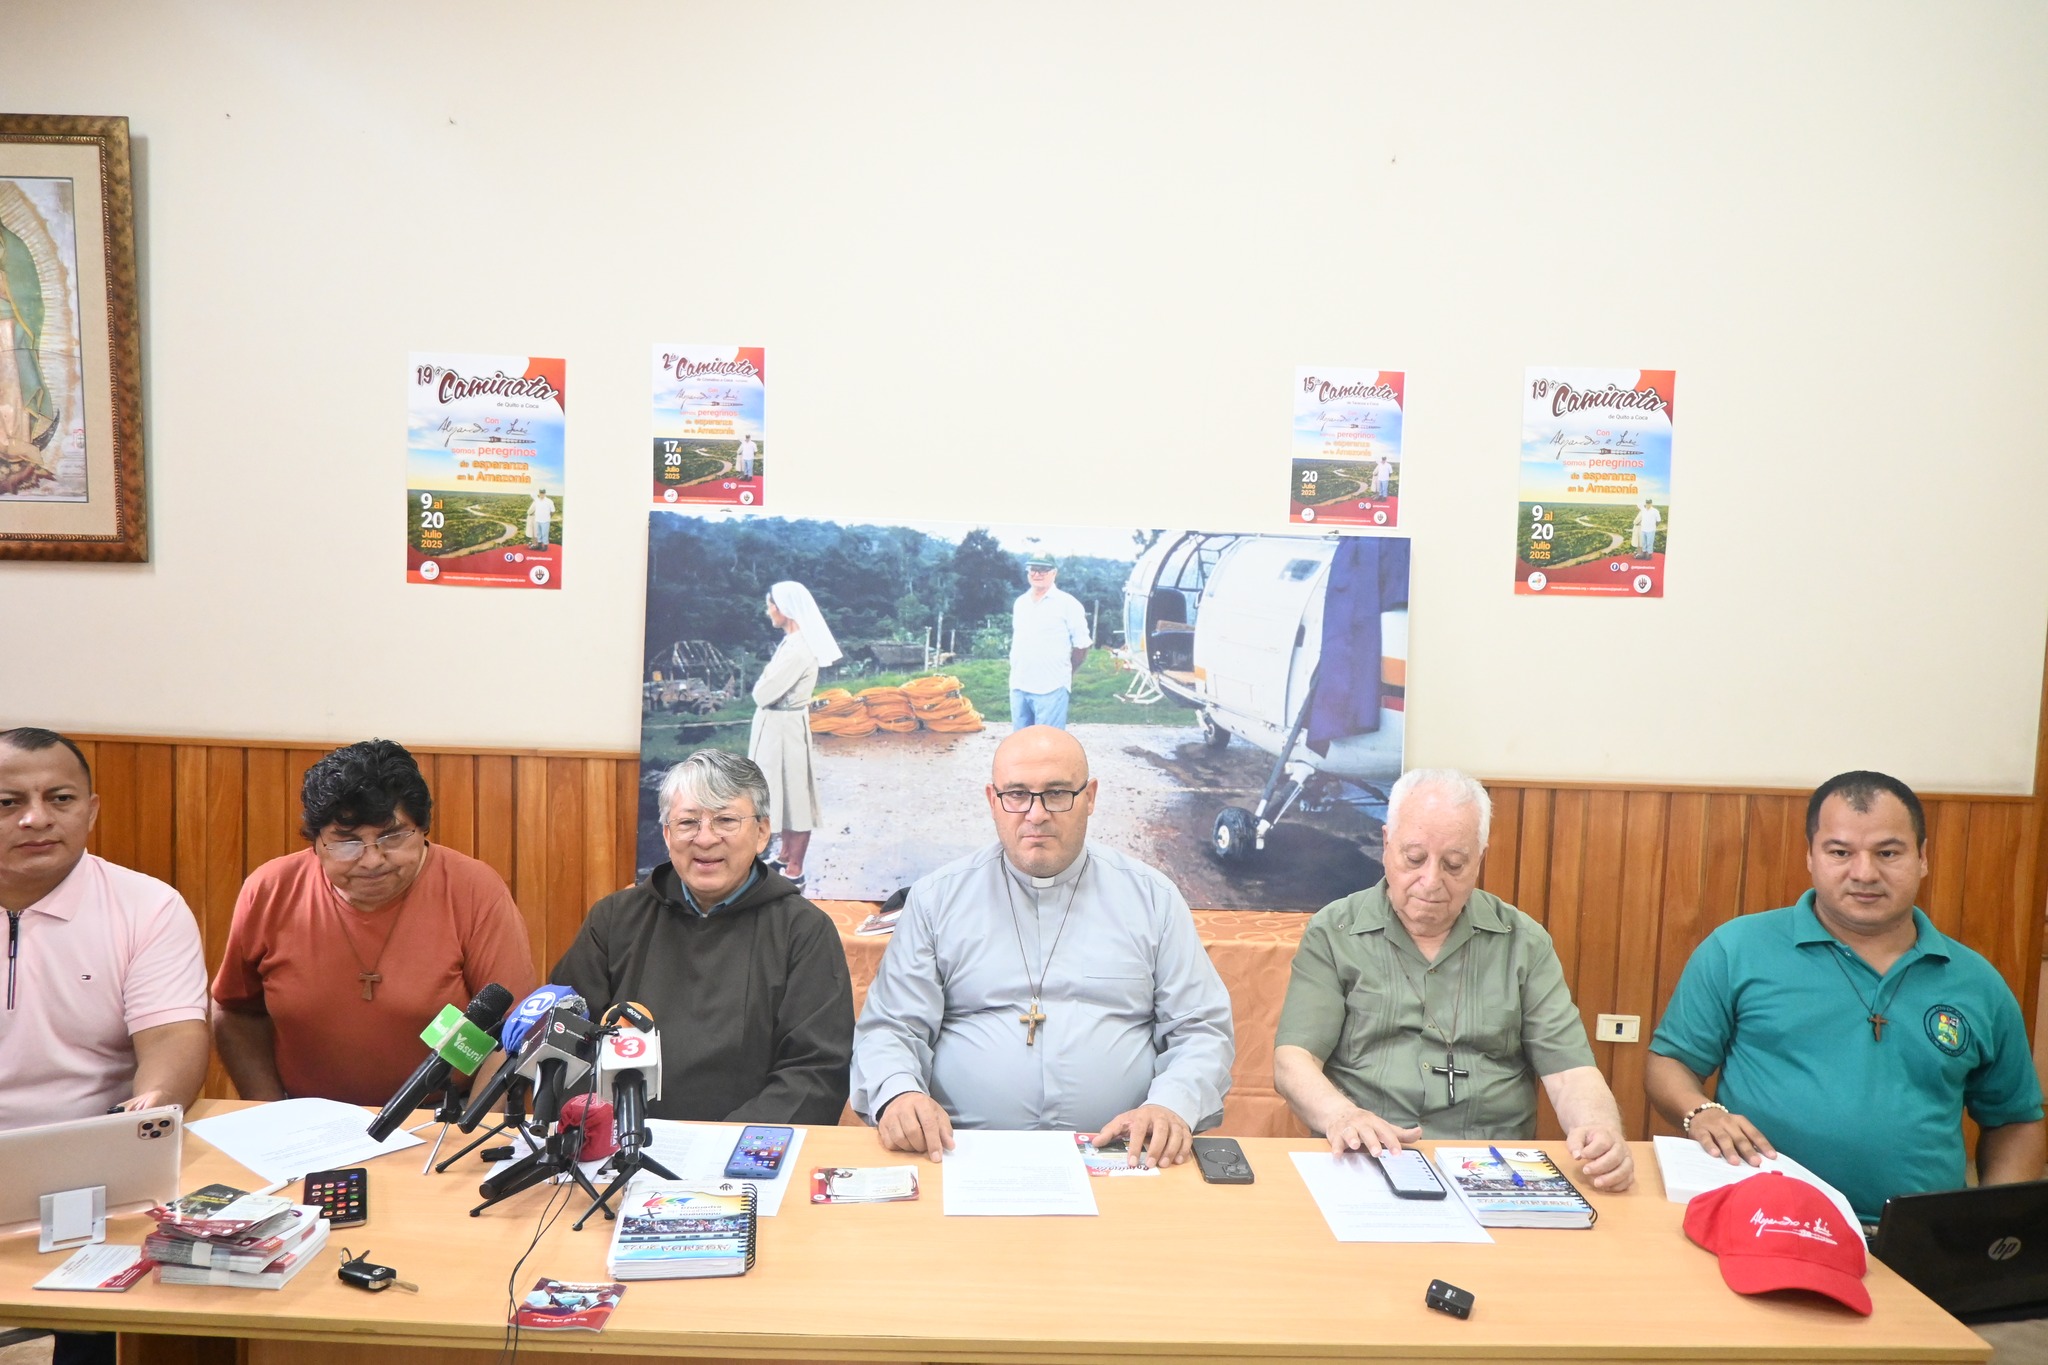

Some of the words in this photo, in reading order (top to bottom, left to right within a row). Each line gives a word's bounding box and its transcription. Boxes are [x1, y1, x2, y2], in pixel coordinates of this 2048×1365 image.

[676, 357, 758, 381] Caminata
[438, 370, 560, 405] Caminata
[1319, 381, 1398, 402] Caminata
[1552, 384, 1669, 418] Caminata
[698, 409, 738, 418] peregrinos
[484, 416, 500, 424] Con
[478, 446, 537, 458] peregrinos
[664, 441, 678, 452] 17
[472, 460, 529, 472] esperanza
[664, 454, 682, 466] 20
[1588, 458, 1644, 470] peregrinos
[476, 472, 532, 484] Amazonía
[1302, 470, 1318, 482] 20
[1582, 472, 1636, 484] esperanza
[1586, 484, 1638, 494] Amazonía
[420, 492, 433, 510] 9
[434, 500, 443, 510] al
[1532, 505, 1543, 521] 9
[1544, 511, 1553, 520] al
[420, 512, 444, 529] 20
[422, 529, 442, 539] Julio
[1531, 523, 1554, 540] 20
[421, 540, 443, 549] 2025
[1530, 540, 1551, 550] Julio
[1530, 550, 1551, 560] 2025
[622, 1039, 640, 1056] 3
[660, 1244, 731, 1252] AGENDA
[1990, 1237, 2020, 1261] hp
